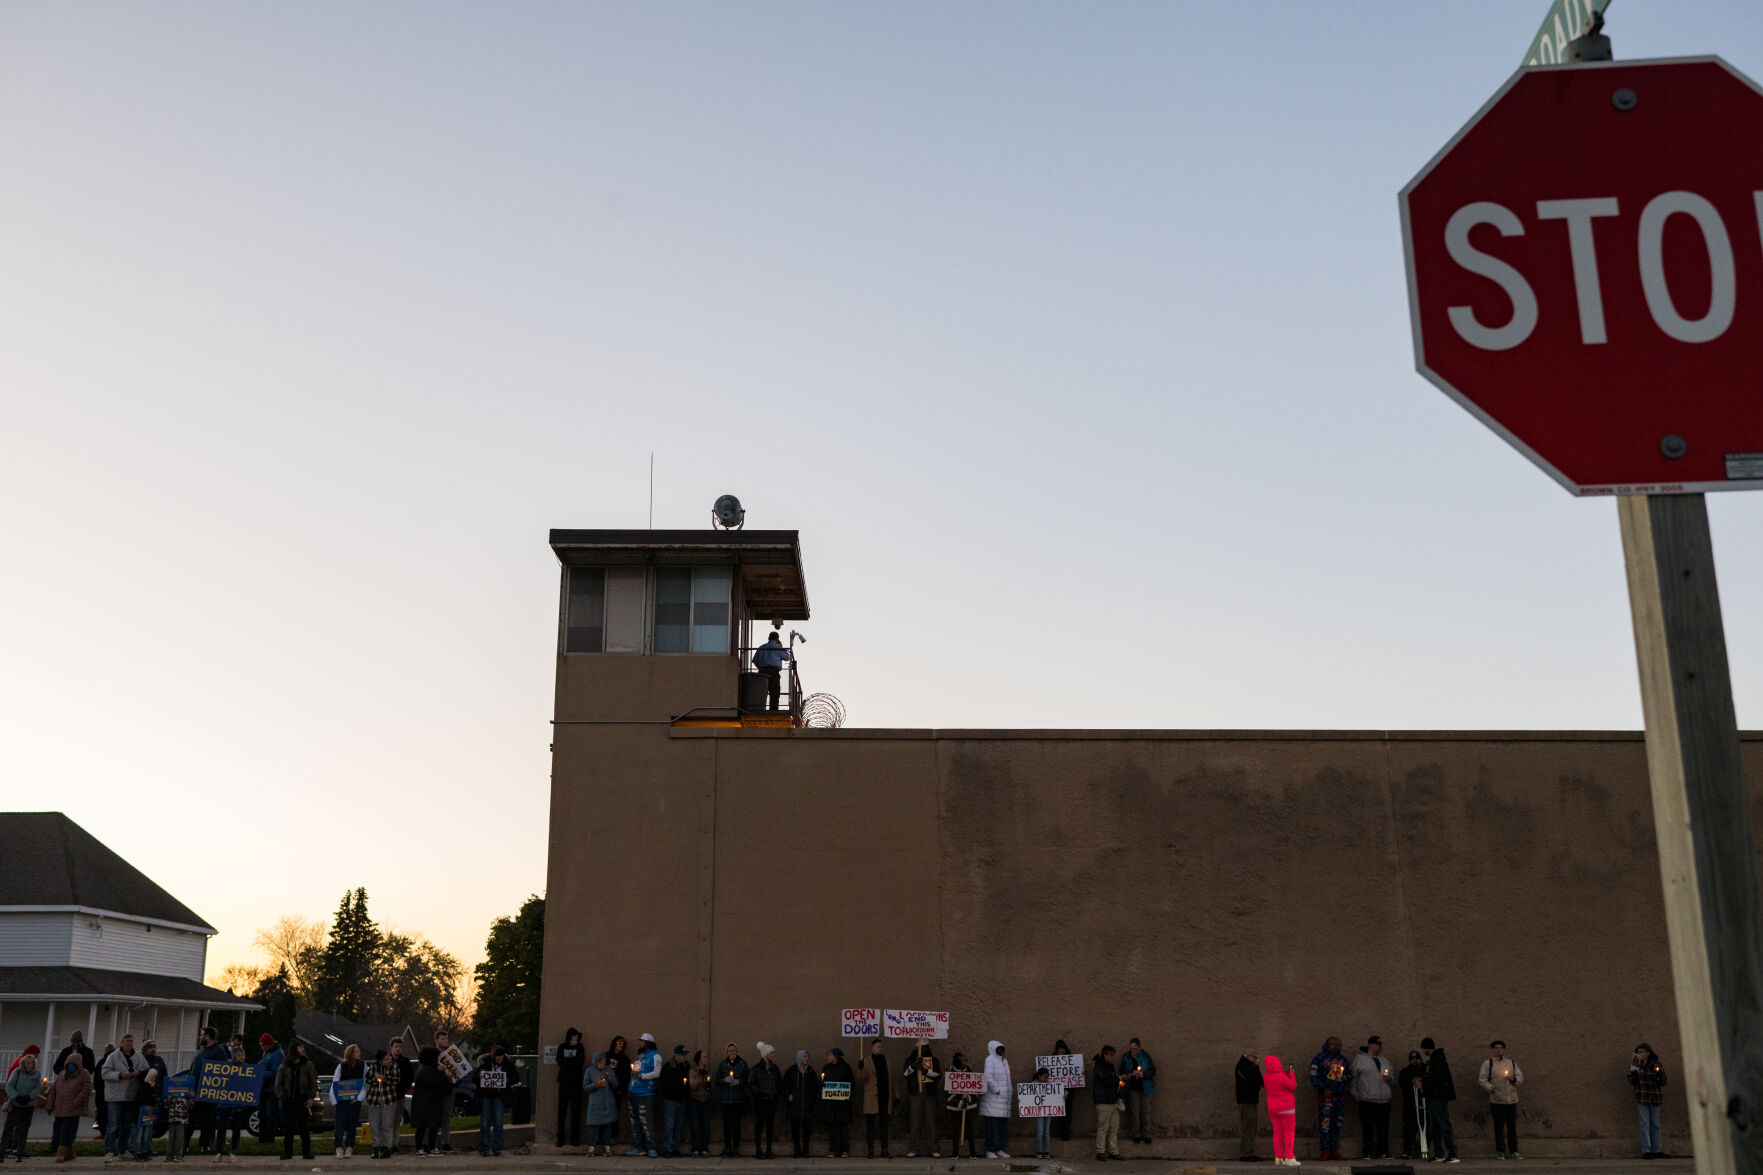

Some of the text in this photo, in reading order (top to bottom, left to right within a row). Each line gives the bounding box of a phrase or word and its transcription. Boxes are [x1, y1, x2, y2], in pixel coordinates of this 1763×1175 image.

[1444, 190, 1763, 351] STO
[844, 1009, 875, 1020] OPEN
[844, 1024, 878, 1034] DOORS
[1037, 1056, 1074, 1067] RELEASE
[204, 1063, 256, 1077] PEOPLE.
[1048, 1066, 1081, 1077] EFORE
[202, 1076, 229, 1087] NOT
[483, 1072, 504, 1080] CLOSE
[949, 1072, 971, 1080] OPEN
[951, 1081, 982, 1089] DOORS
[1018, 1084, 1061, 1095] DEPARTMENT
[199, 1088, 256, 1102] PRISONS.
[1034, 1095, 1046, 1105] OF
[1019, 1106, 1064, 1116] CORRUPTION
